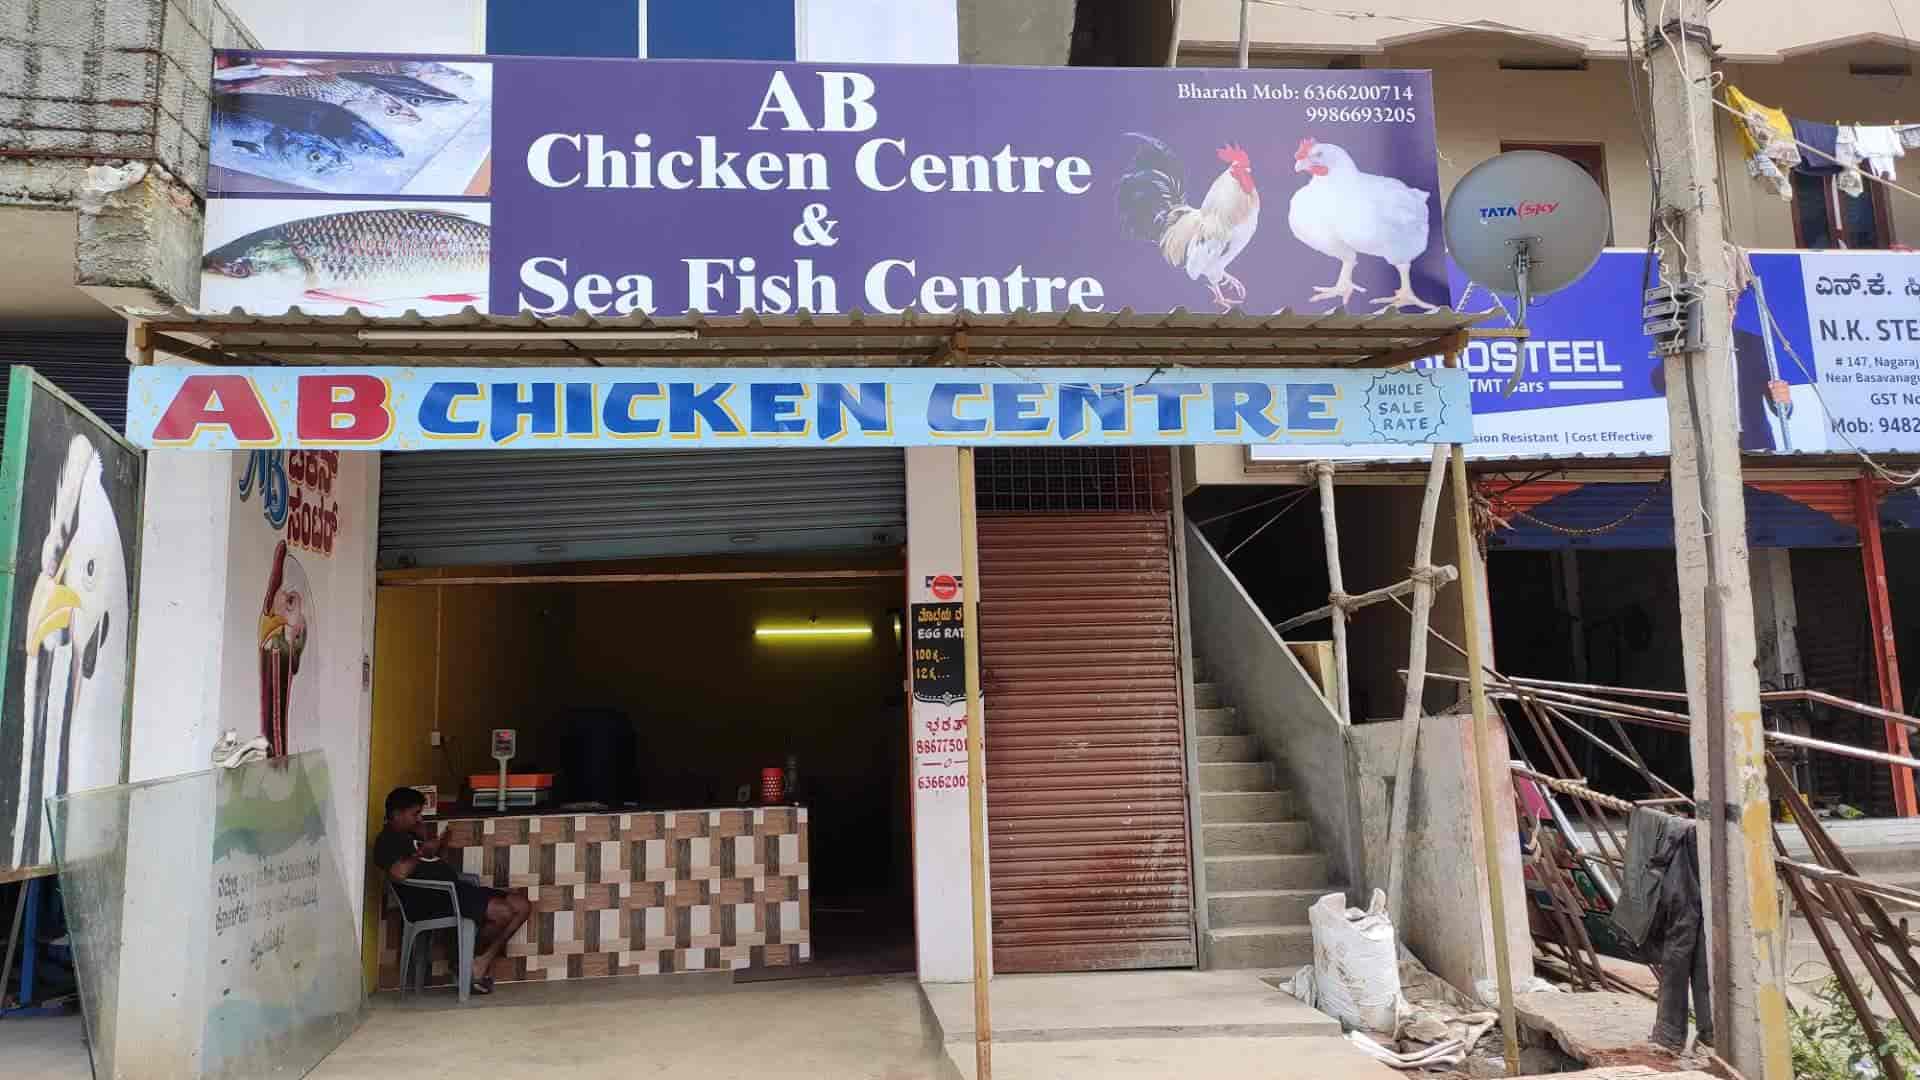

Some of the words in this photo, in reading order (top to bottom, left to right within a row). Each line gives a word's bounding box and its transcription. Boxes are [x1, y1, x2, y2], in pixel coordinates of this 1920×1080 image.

[1177, 83, 1247, 100] Bharath
[1252, 84, 1299, 100] Mob:
[1303, 85, 1413, 101] 6366200714
[748, 70, 878, 132] AB
[1306, 107, 1416, 123] 9986693205
[526, 132, 831, 191] Chicken
[854, 137, 1094, 194] Centre
[1480, 207, 1517, 217] TATA
[793, 202, 839, 247] &
[518, 256, 657, 317] Sea
[681, 256, 838, 315] Fish
[864, 258, 1105, 315] Centre
[1819, 319, 1870, 341] N.K.
[1409, 341, 1622, 373] OSTEEL
[1378, 383, 1424, 396] WHOLE
[1468, 378, 1503, 393] TMT
[1506, 379, 1545, 393] ars
[1870, 393, 1897, 405] GST
[418, 381, 893, 444] CHICKEN
[926, 382, 1344, 442] CENTRE
[1378, 401, 1425, 415] SALE
[1383, 417, 1428, 431] RATE
[1831, 417, 1873, 433] Mob:
[1879, 417, 1920, 433] 9482
[1502, 431, 1560, 443] Resistant
[1571, 432, 1598, 443] Cost
[1601, 431, 1654, 442] Effective
[918, 628, 941, 639] EGG
[944, 627, 965, 639] RAT
